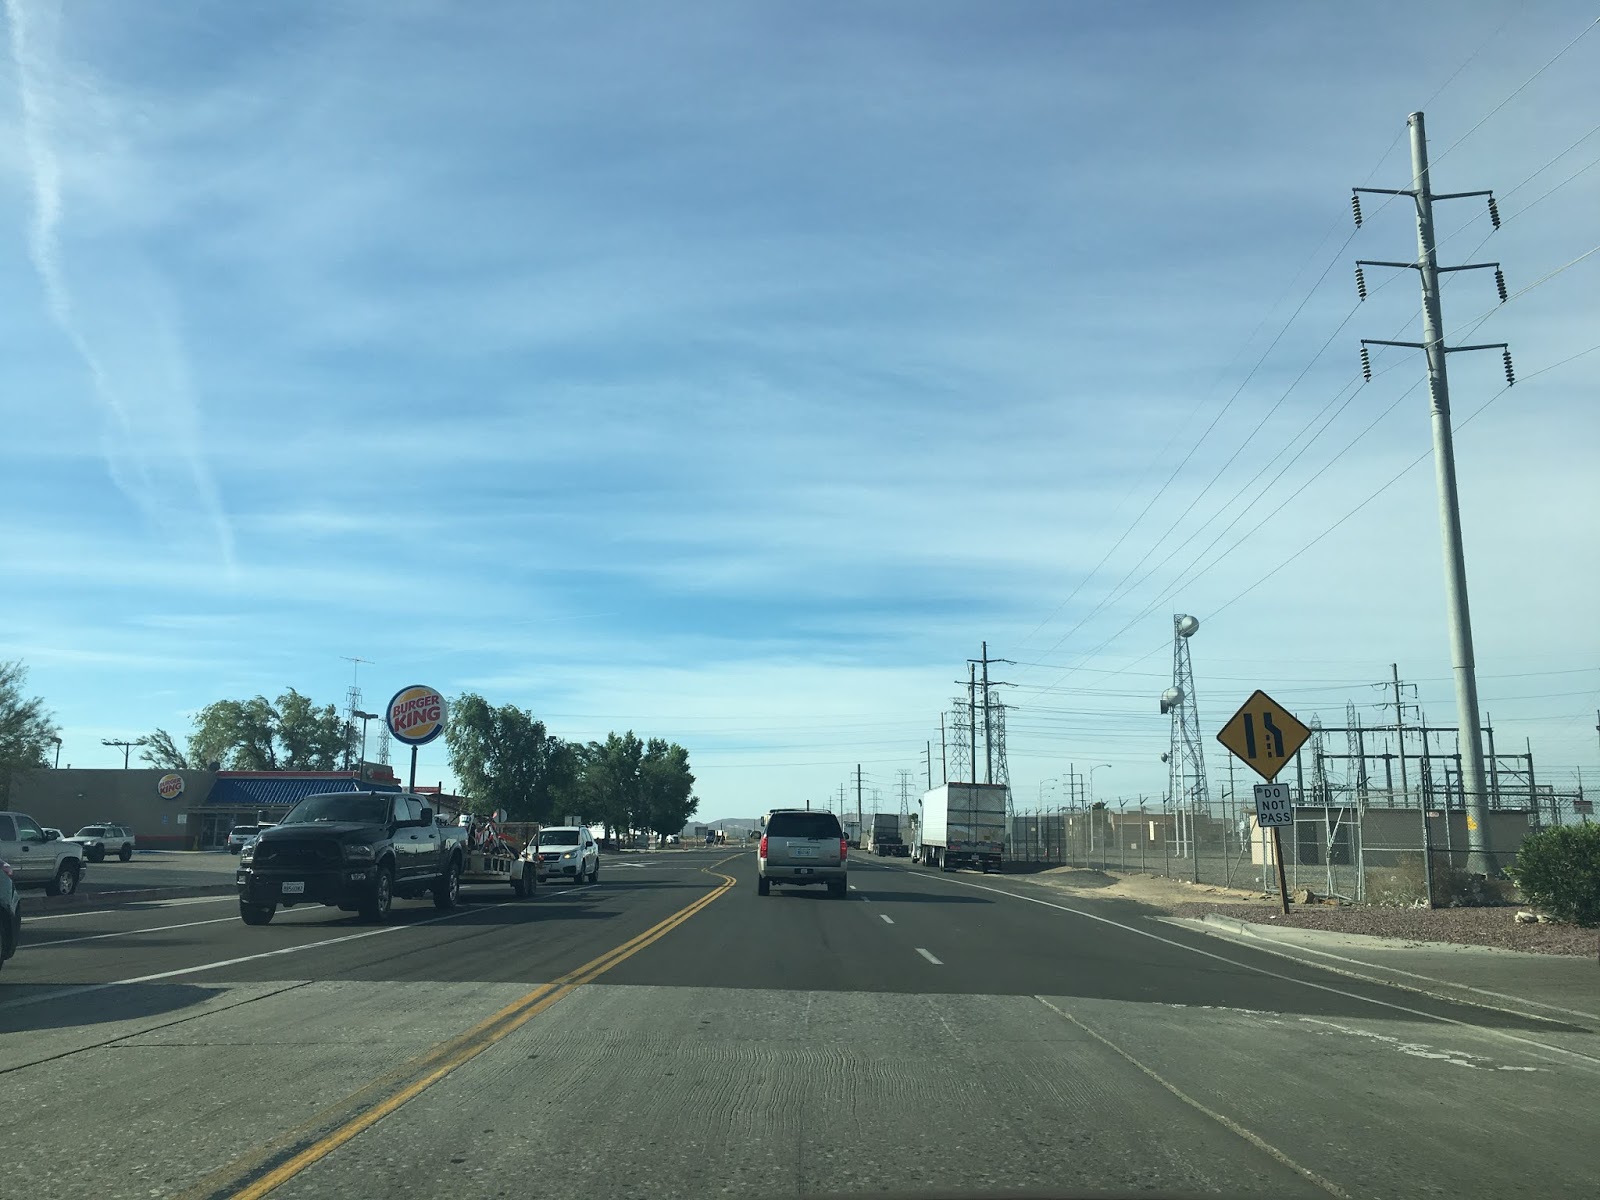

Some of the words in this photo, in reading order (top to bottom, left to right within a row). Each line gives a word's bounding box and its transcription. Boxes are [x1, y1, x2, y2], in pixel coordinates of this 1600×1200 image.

[393, 695, 440, 718] BURGER
[394, 706, 441, 733] KING
[160, 783, 182, 795] KING
[1264, 788, 1281, 798] DO
[1262, 800, 1285, 811] NOT
[1260, 812, 1291, 823] PASS
